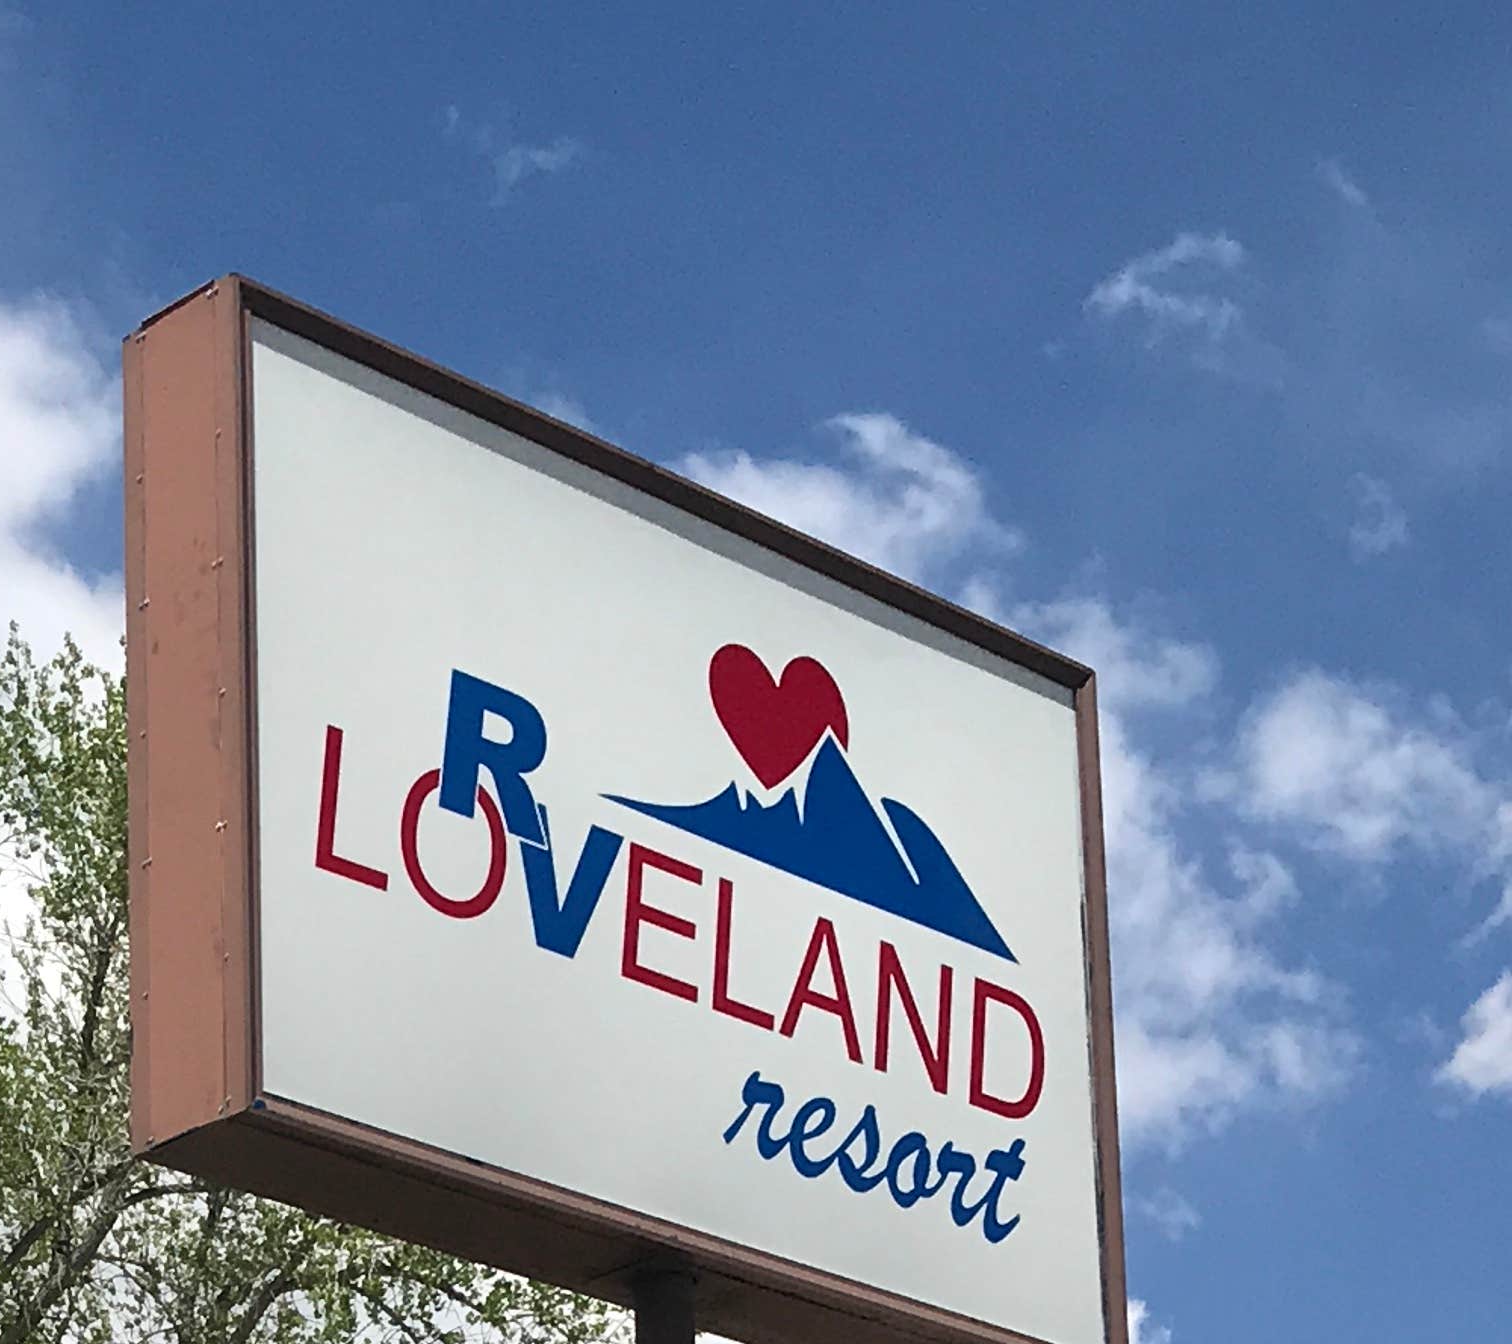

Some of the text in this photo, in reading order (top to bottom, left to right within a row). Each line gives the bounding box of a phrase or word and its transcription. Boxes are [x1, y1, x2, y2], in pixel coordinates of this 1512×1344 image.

[315, 725, 1045, 1120] LOVELAND
[438, 668, 624, 959] RV
[723, 1071, 1027, 1244] resort
